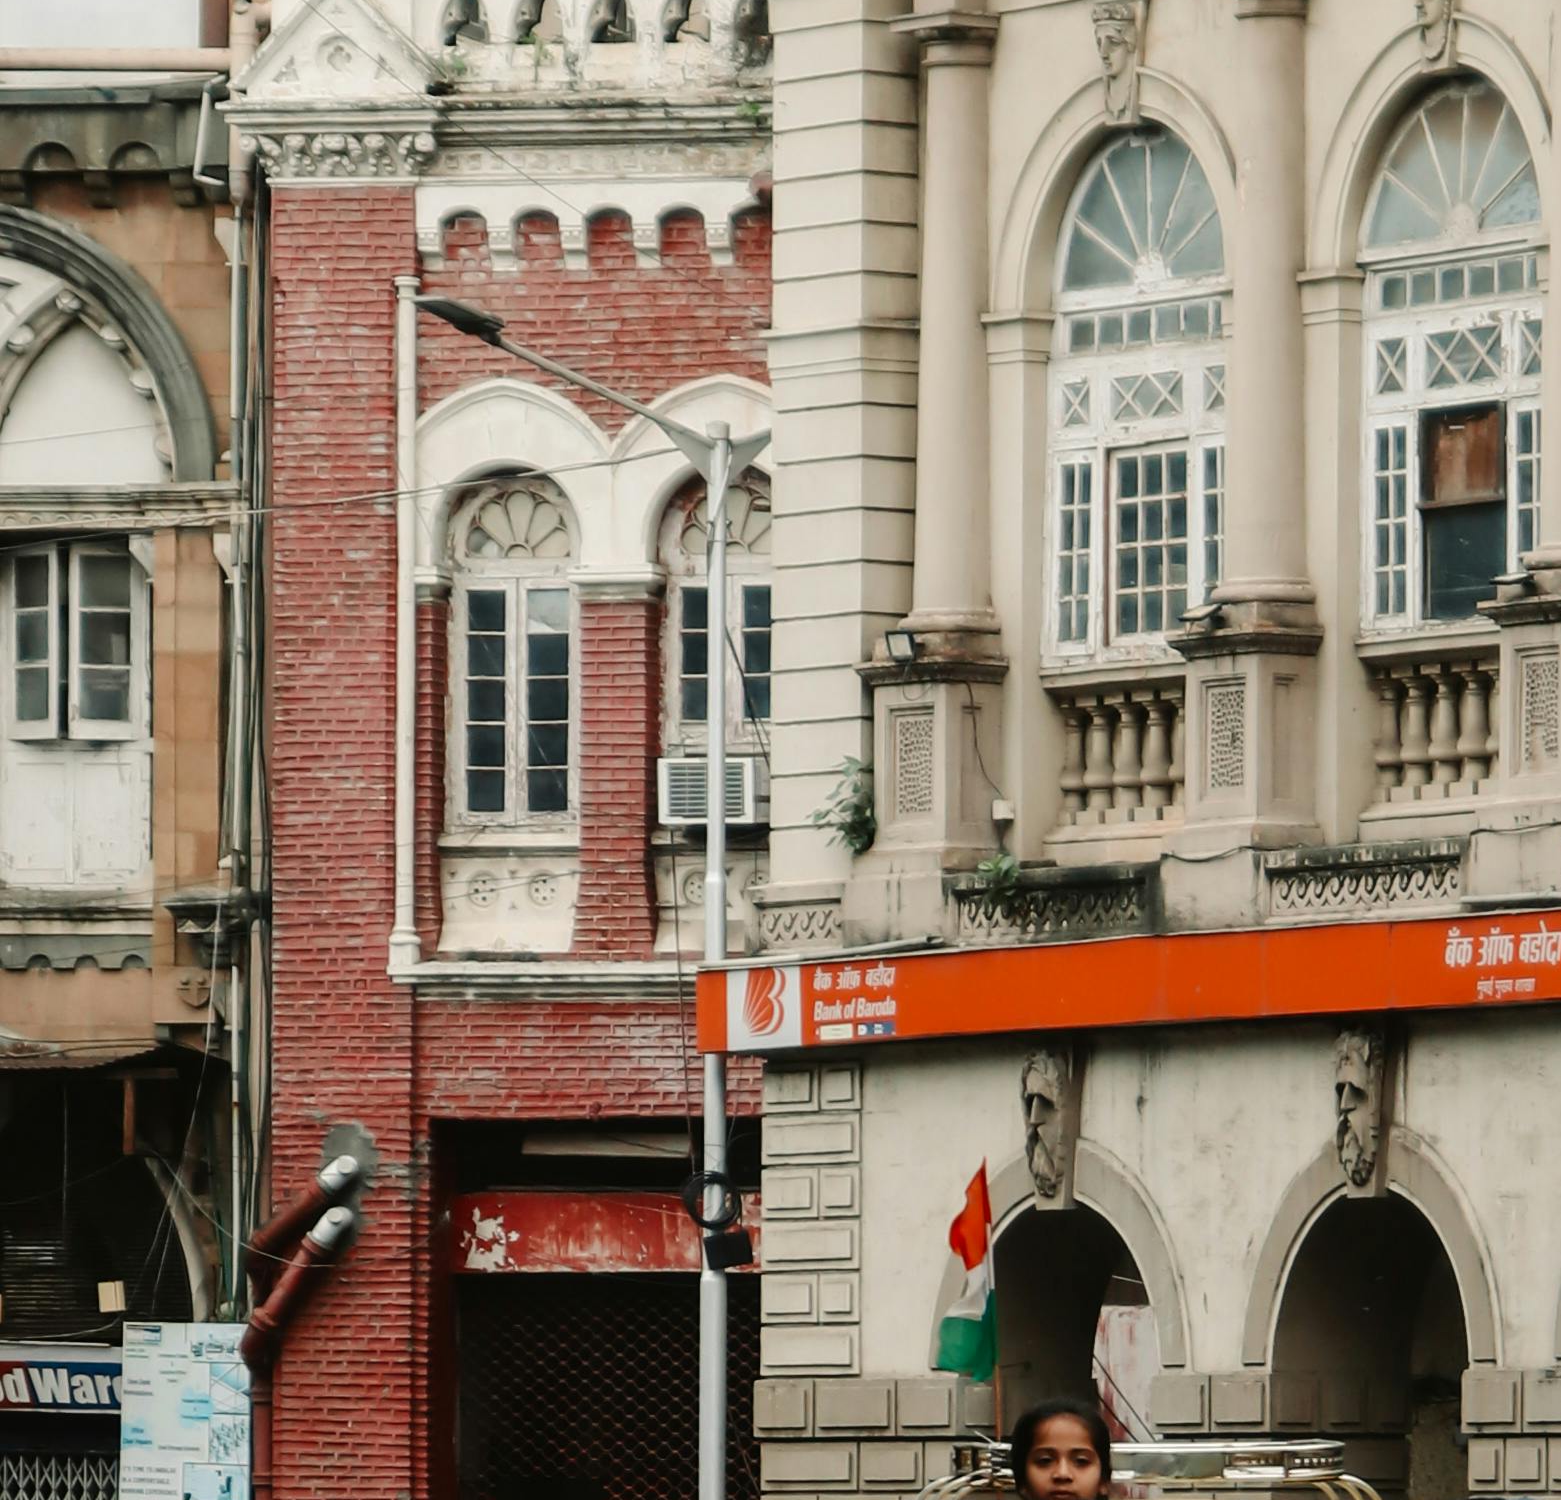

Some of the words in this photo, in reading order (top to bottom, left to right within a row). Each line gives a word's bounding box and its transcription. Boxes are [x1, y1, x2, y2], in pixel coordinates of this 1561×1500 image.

[814, 1000, 842, 1022] Bank
[844, 998, 856, 1019] of
[856, 995, 897, 1018] Baroda
